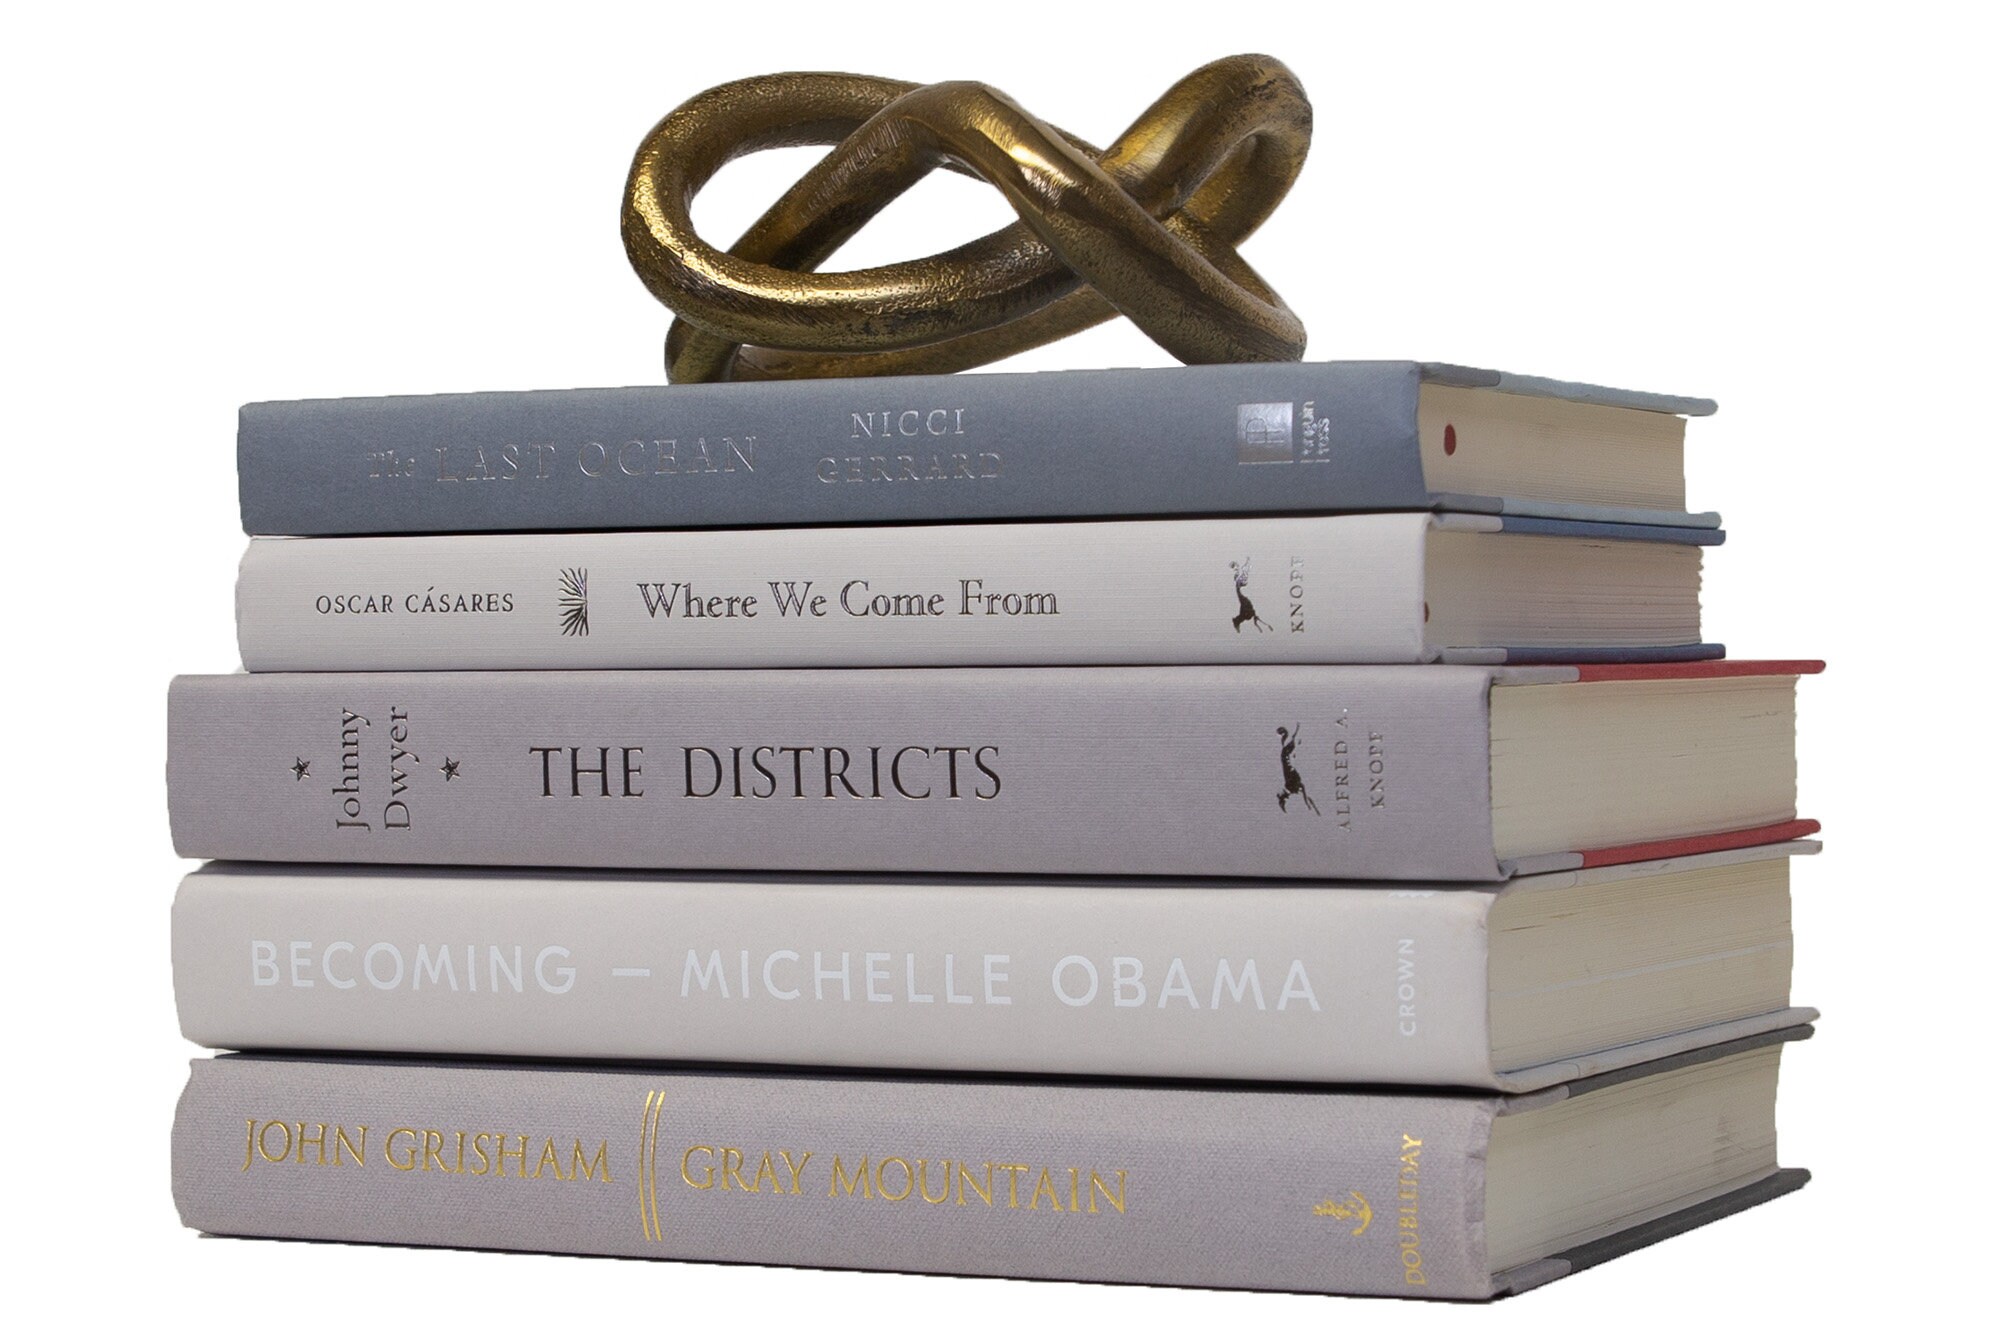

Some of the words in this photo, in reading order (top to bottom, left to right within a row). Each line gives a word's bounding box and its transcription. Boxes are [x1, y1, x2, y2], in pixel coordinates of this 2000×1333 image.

[435, 441, 556, 482] LAST
[577, 435, 758, 478] OCEAN
[851, 408, 966, 438] NICCI
[815, 452, 1002, 484] GERRARD
[315, 594, 394, 615] OSCAR
[405, 586, 515, 614] CÁSARES
[637, 581, 758, 619] Where
[768, 580, 828, 618] We
[839, 579, 945, 618] Come
[958, 578, 1061, 616] From
[1289, 556, 1305, 633] KNOPF
[332, 706, 371, 833] Johnny
[383, 706, 420, 831] Dwyer
[528, 745, 645, 799] THE
[680, 745, 1002, 801] DISTRICTS
[1334, 740, 1352, 832] ALFRED
[1368, 730, 1385, 809] KNOPF
[251, 939, 577, 995] BECOMING
[679, 949, 1013, 1005] MICHELLE
[1051, 954, 1321, 1012] OBAMA
[1398, 938, 1417, 1036] CROWN
[240, 1118, 369, 1172] JOHN
[385, 1127, 615, 1184] GRISHAM
[680, 1144, 813, 1195] GRAY
[827, 1153, 1129, 1214] MOUNTAIN
[1399, 1133, 1428, 1286] DOUBLEDAY
